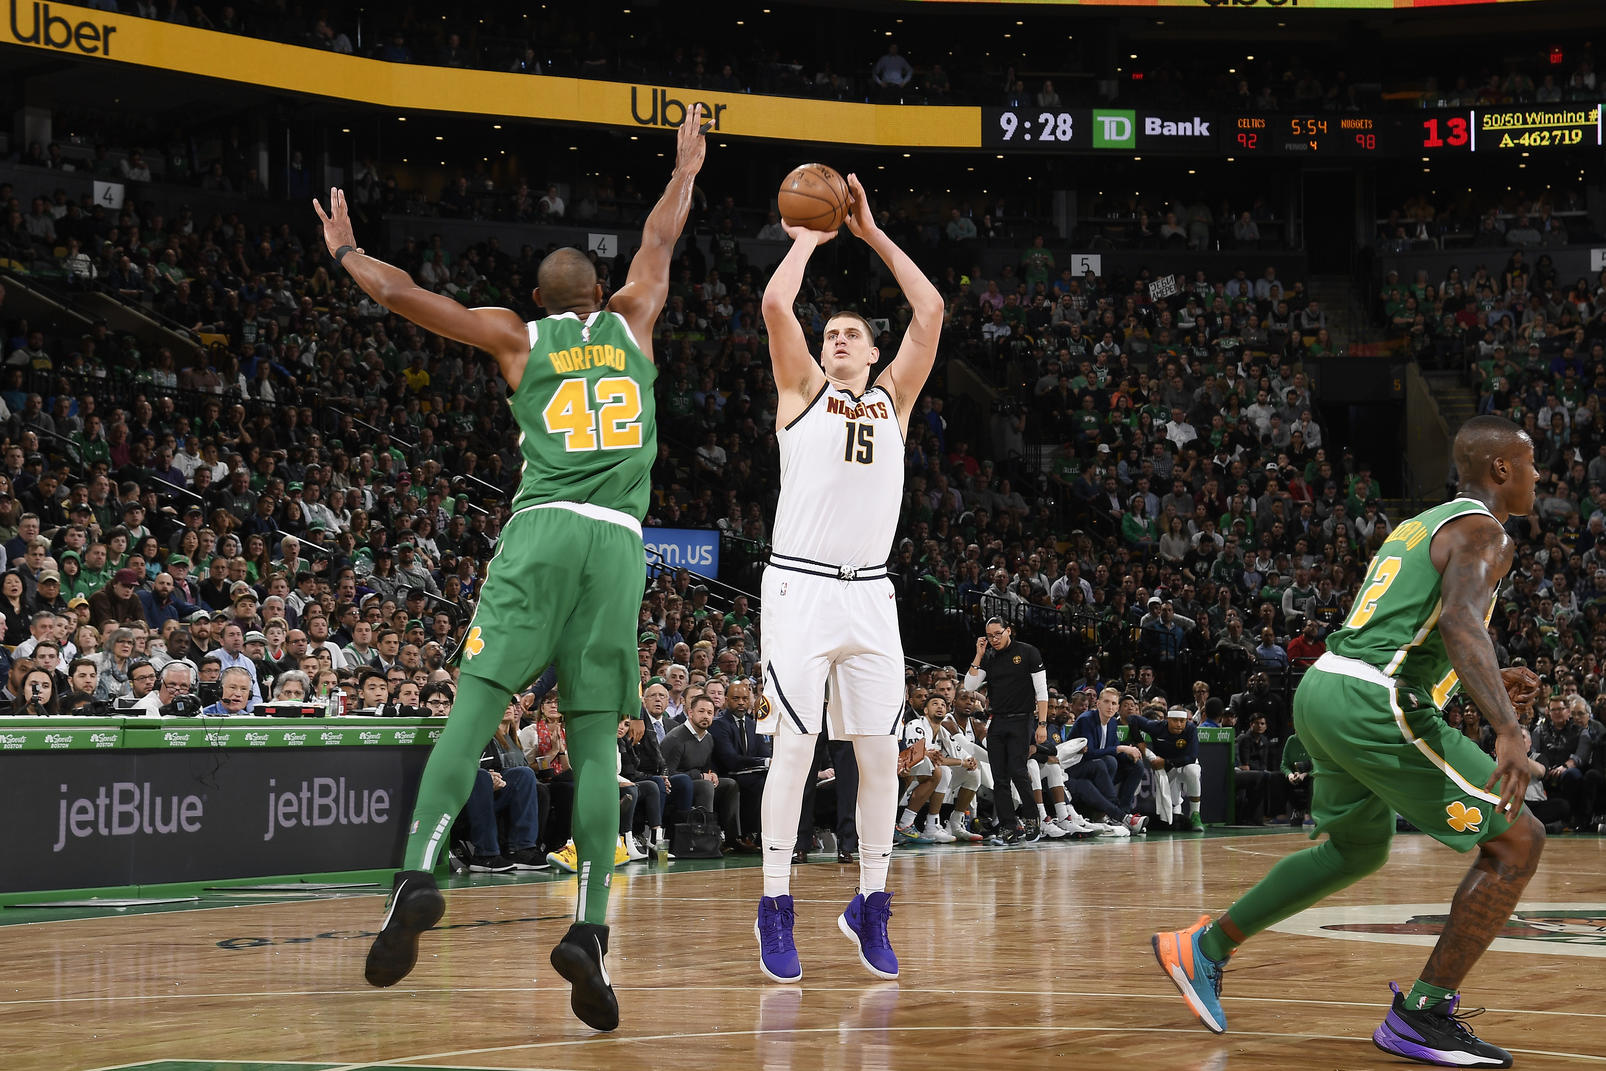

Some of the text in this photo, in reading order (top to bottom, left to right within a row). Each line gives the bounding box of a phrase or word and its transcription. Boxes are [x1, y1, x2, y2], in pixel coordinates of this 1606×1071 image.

[10, 0, 117, 56] Uber
[999, 112, 1073, 141] 9:28
[1237, 118, 1266, 129] CELTICS
[1291, 119, 1328, 135] 5:54
[1341, 119, 1373, 129] NUGGETS
[1483, 112, 1523, 127] 50/50
[1526, 110, 1585, 125] Winning
[1097, 116, 1210, 141] TD Bank
[1423, 117, 1468, 148] 13
[1237, 133, 1257, 149] 92
[1309, 139, 1318, 151] 4
[1356, 134, 1376, 150] 98
[1499, 129, 1583, 148] A-462719
[103, 186, 114, 205] 4
[597, 237, 608, 254] 4
[1080, 257, 1090, 274] 5
[548, 344, 626, 374] HORFORD
[542, 376, 643, 452] 42
[844, 421, 874, 465] 15
[53, 777, 391, 852] jetBlue jetBlue
